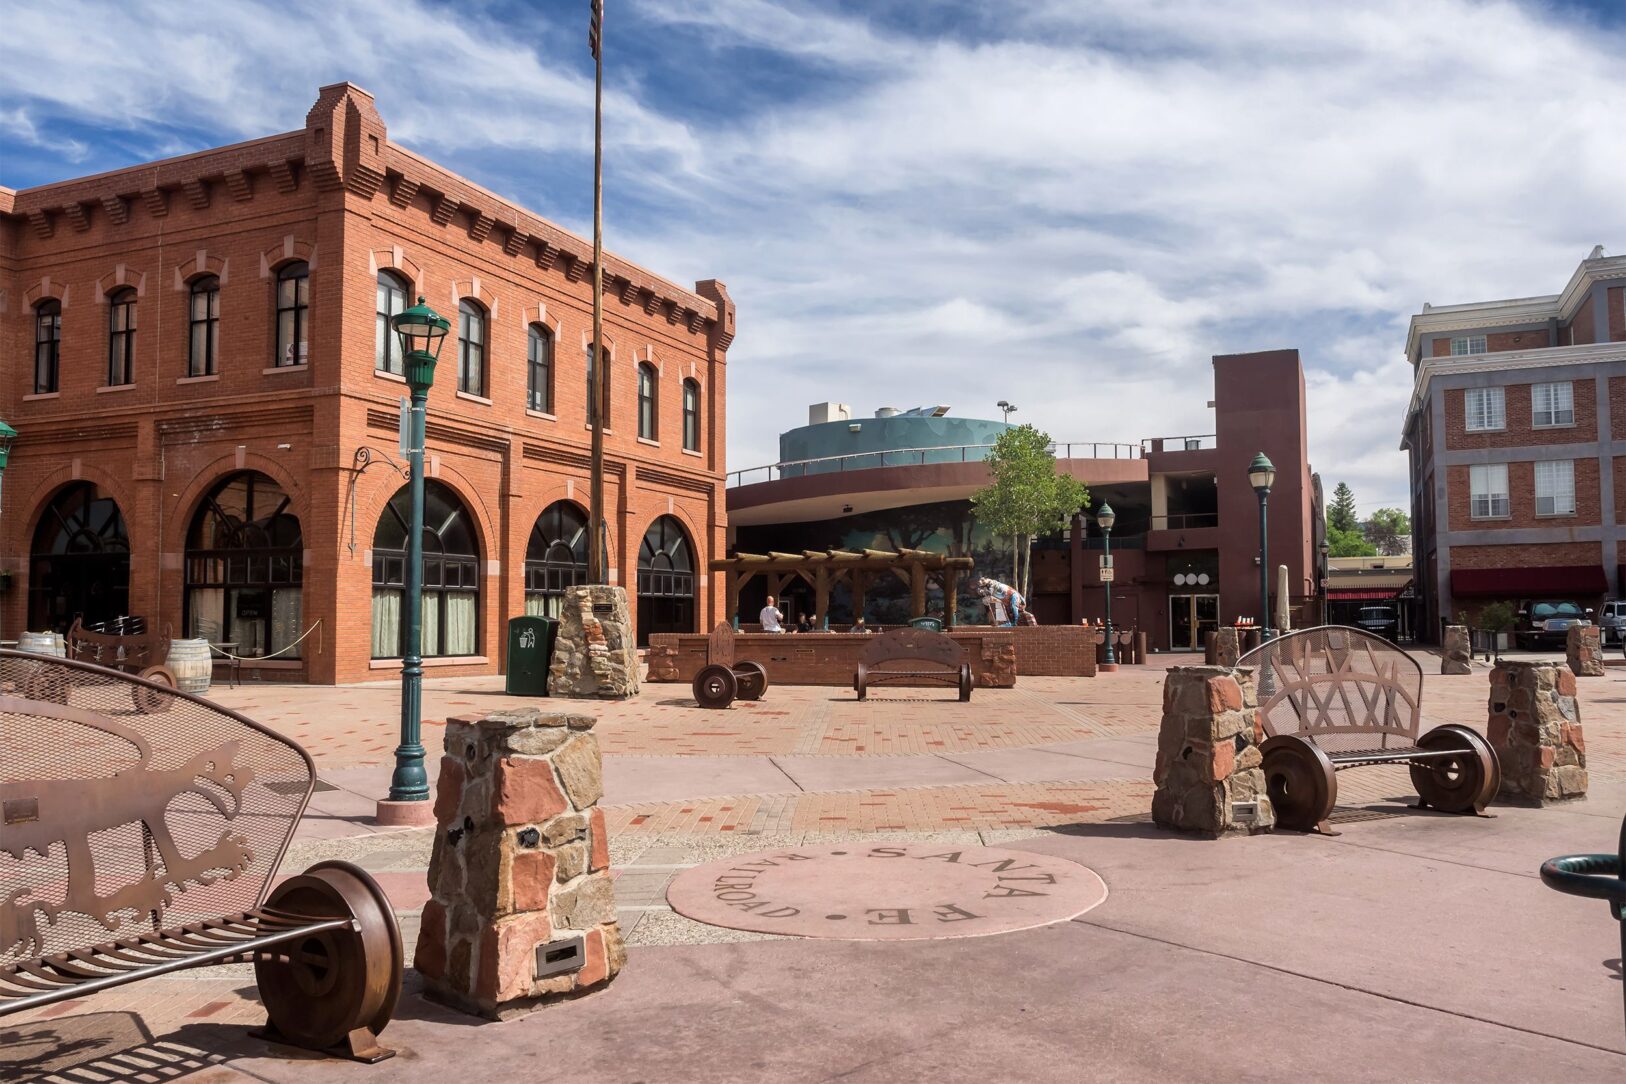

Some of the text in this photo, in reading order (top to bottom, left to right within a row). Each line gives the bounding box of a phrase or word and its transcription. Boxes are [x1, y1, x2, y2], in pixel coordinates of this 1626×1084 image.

[713, 852, 813, 918] RAILROAD
[866, 846, 1057, 925] SANTA FE
